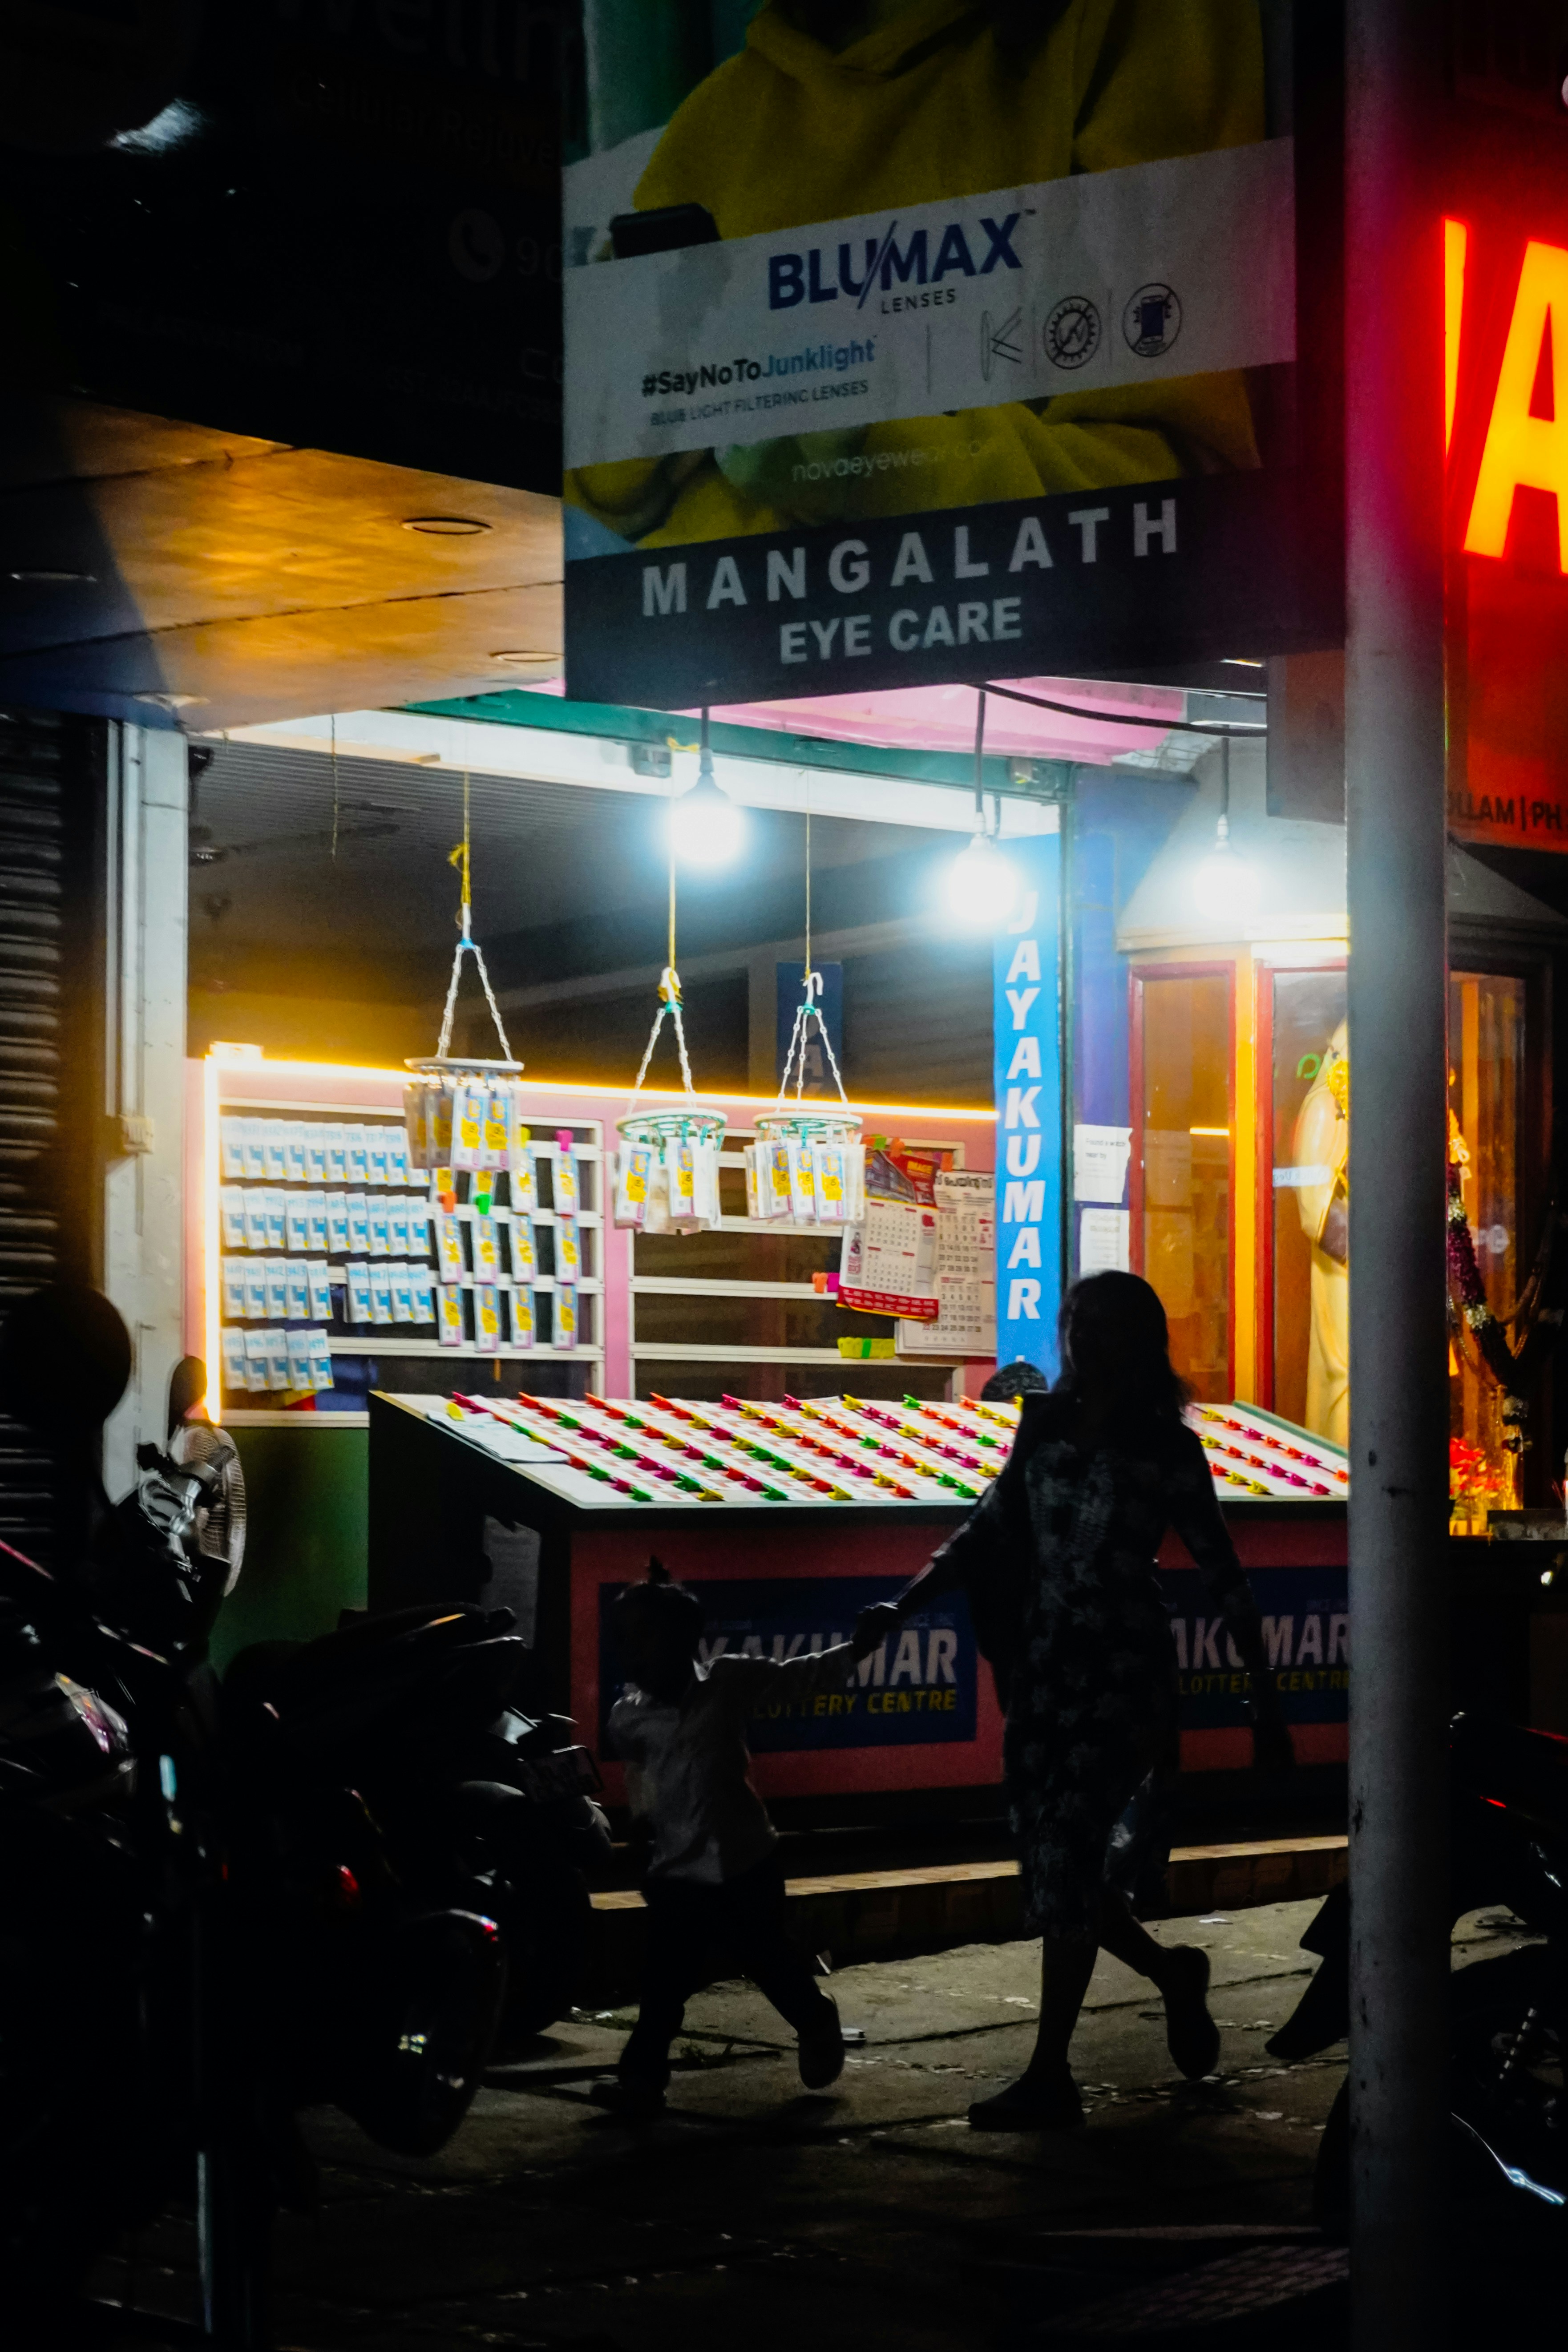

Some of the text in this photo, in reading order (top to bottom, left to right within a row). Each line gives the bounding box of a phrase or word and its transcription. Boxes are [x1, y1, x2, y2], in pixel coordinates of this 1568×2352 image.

[881, 288, 957, 314] LENSES
[642, 339, 875, 398] #SayNoToJunklight
[690, 401, 732, 420] LIGHT
[734, 389, 808, 412] FILTERING
[811, 380, 869, 401] LENSES
[642, 499, 1178, 617] MANGALATH
[780, 597, 1023, 664] EYE CARE
[866, 1689, 957, 1715] CENTRE
